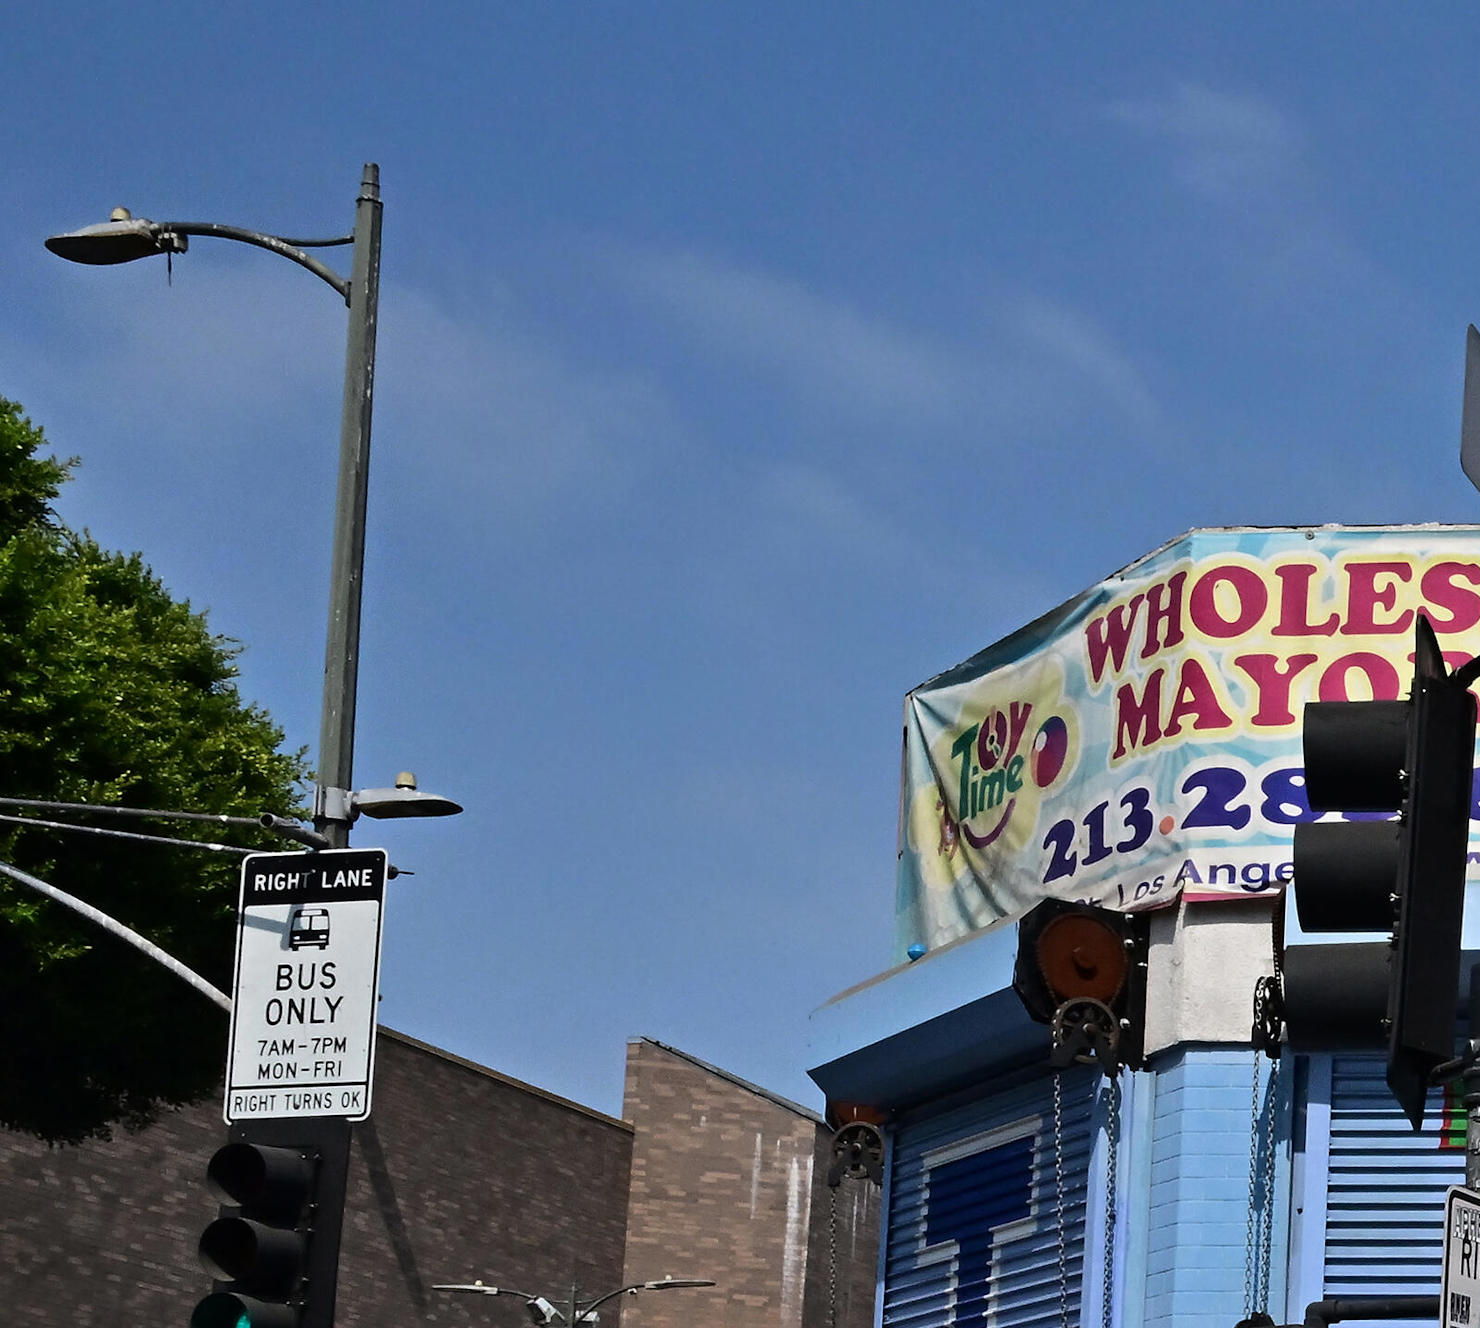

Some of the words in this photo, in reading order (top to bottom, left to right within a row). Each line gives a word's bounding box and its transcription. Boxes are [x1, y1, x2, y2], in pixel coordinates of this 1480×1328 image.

[253, 871, 310, 892] RIGHT
[321, 869, 373, 889] LANE
[1173, 859, 1294, 893] Ange
[276, 961, 337, 992] BUS
[265, 996, 345, 1026] ONLY
[257, 1060, 342, 1081] MON-FRI
[234, 1093, 277, 1114] RIGHT
[284, 1091, 332, 1112] TURNS
[341, 1090, 362, 1109] OK
